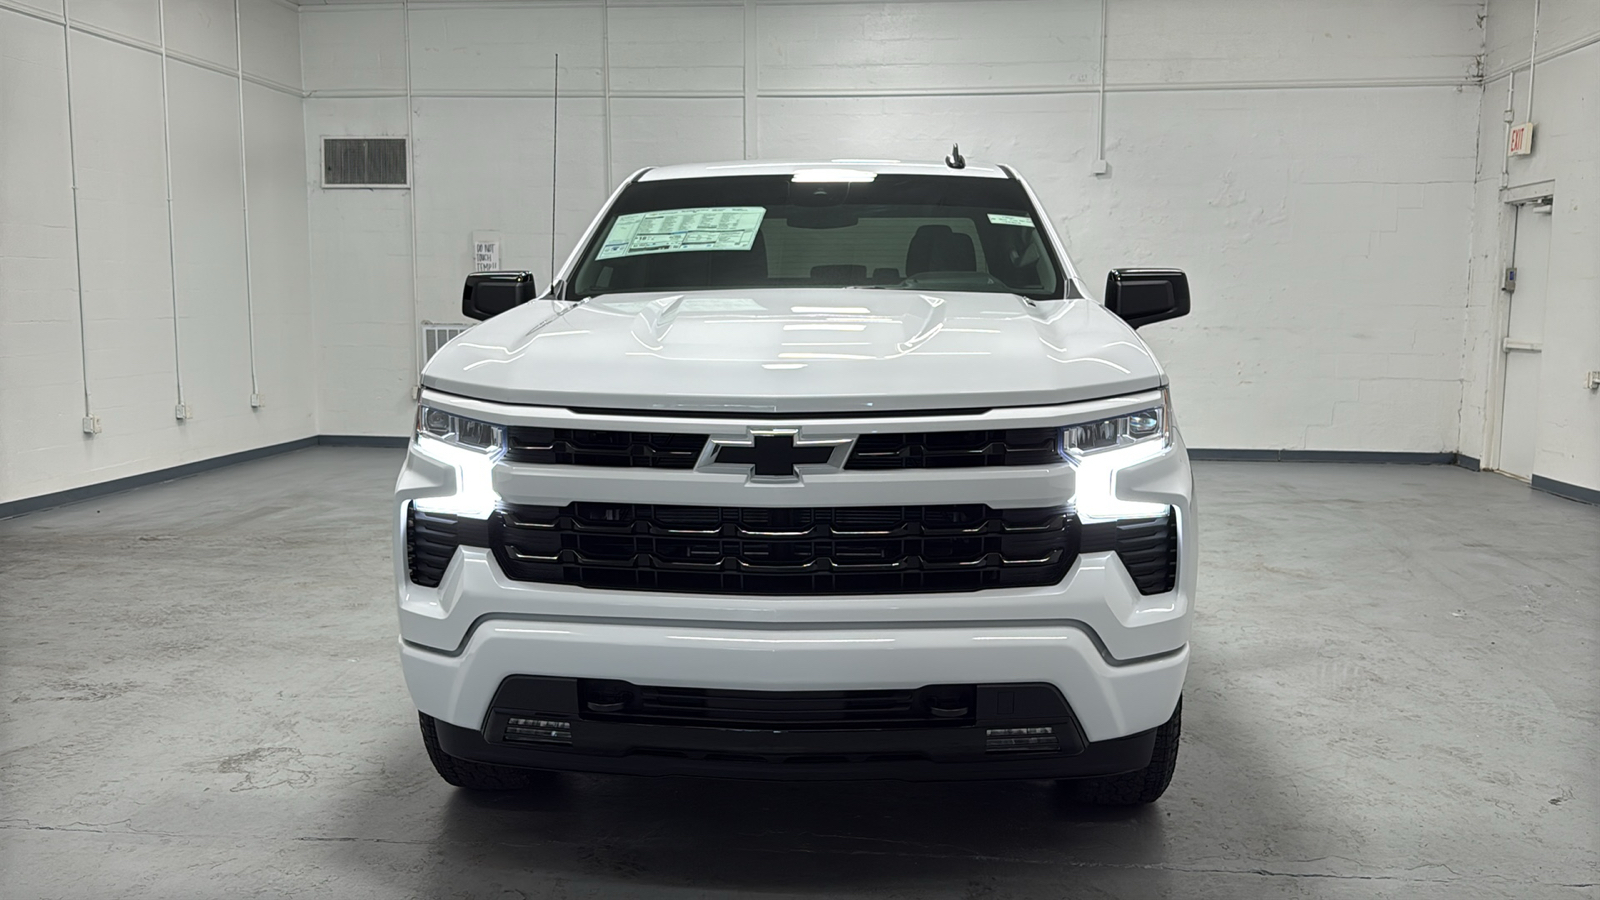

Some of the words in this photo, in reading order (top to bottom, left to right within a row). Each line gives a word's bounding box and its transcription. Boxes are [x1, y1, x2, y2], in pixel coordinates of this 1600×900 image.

[1511, 128, 1524, 152] EXIT
[476, 243, 483, 253] DO
[484, 243, 495, 253] NOT
